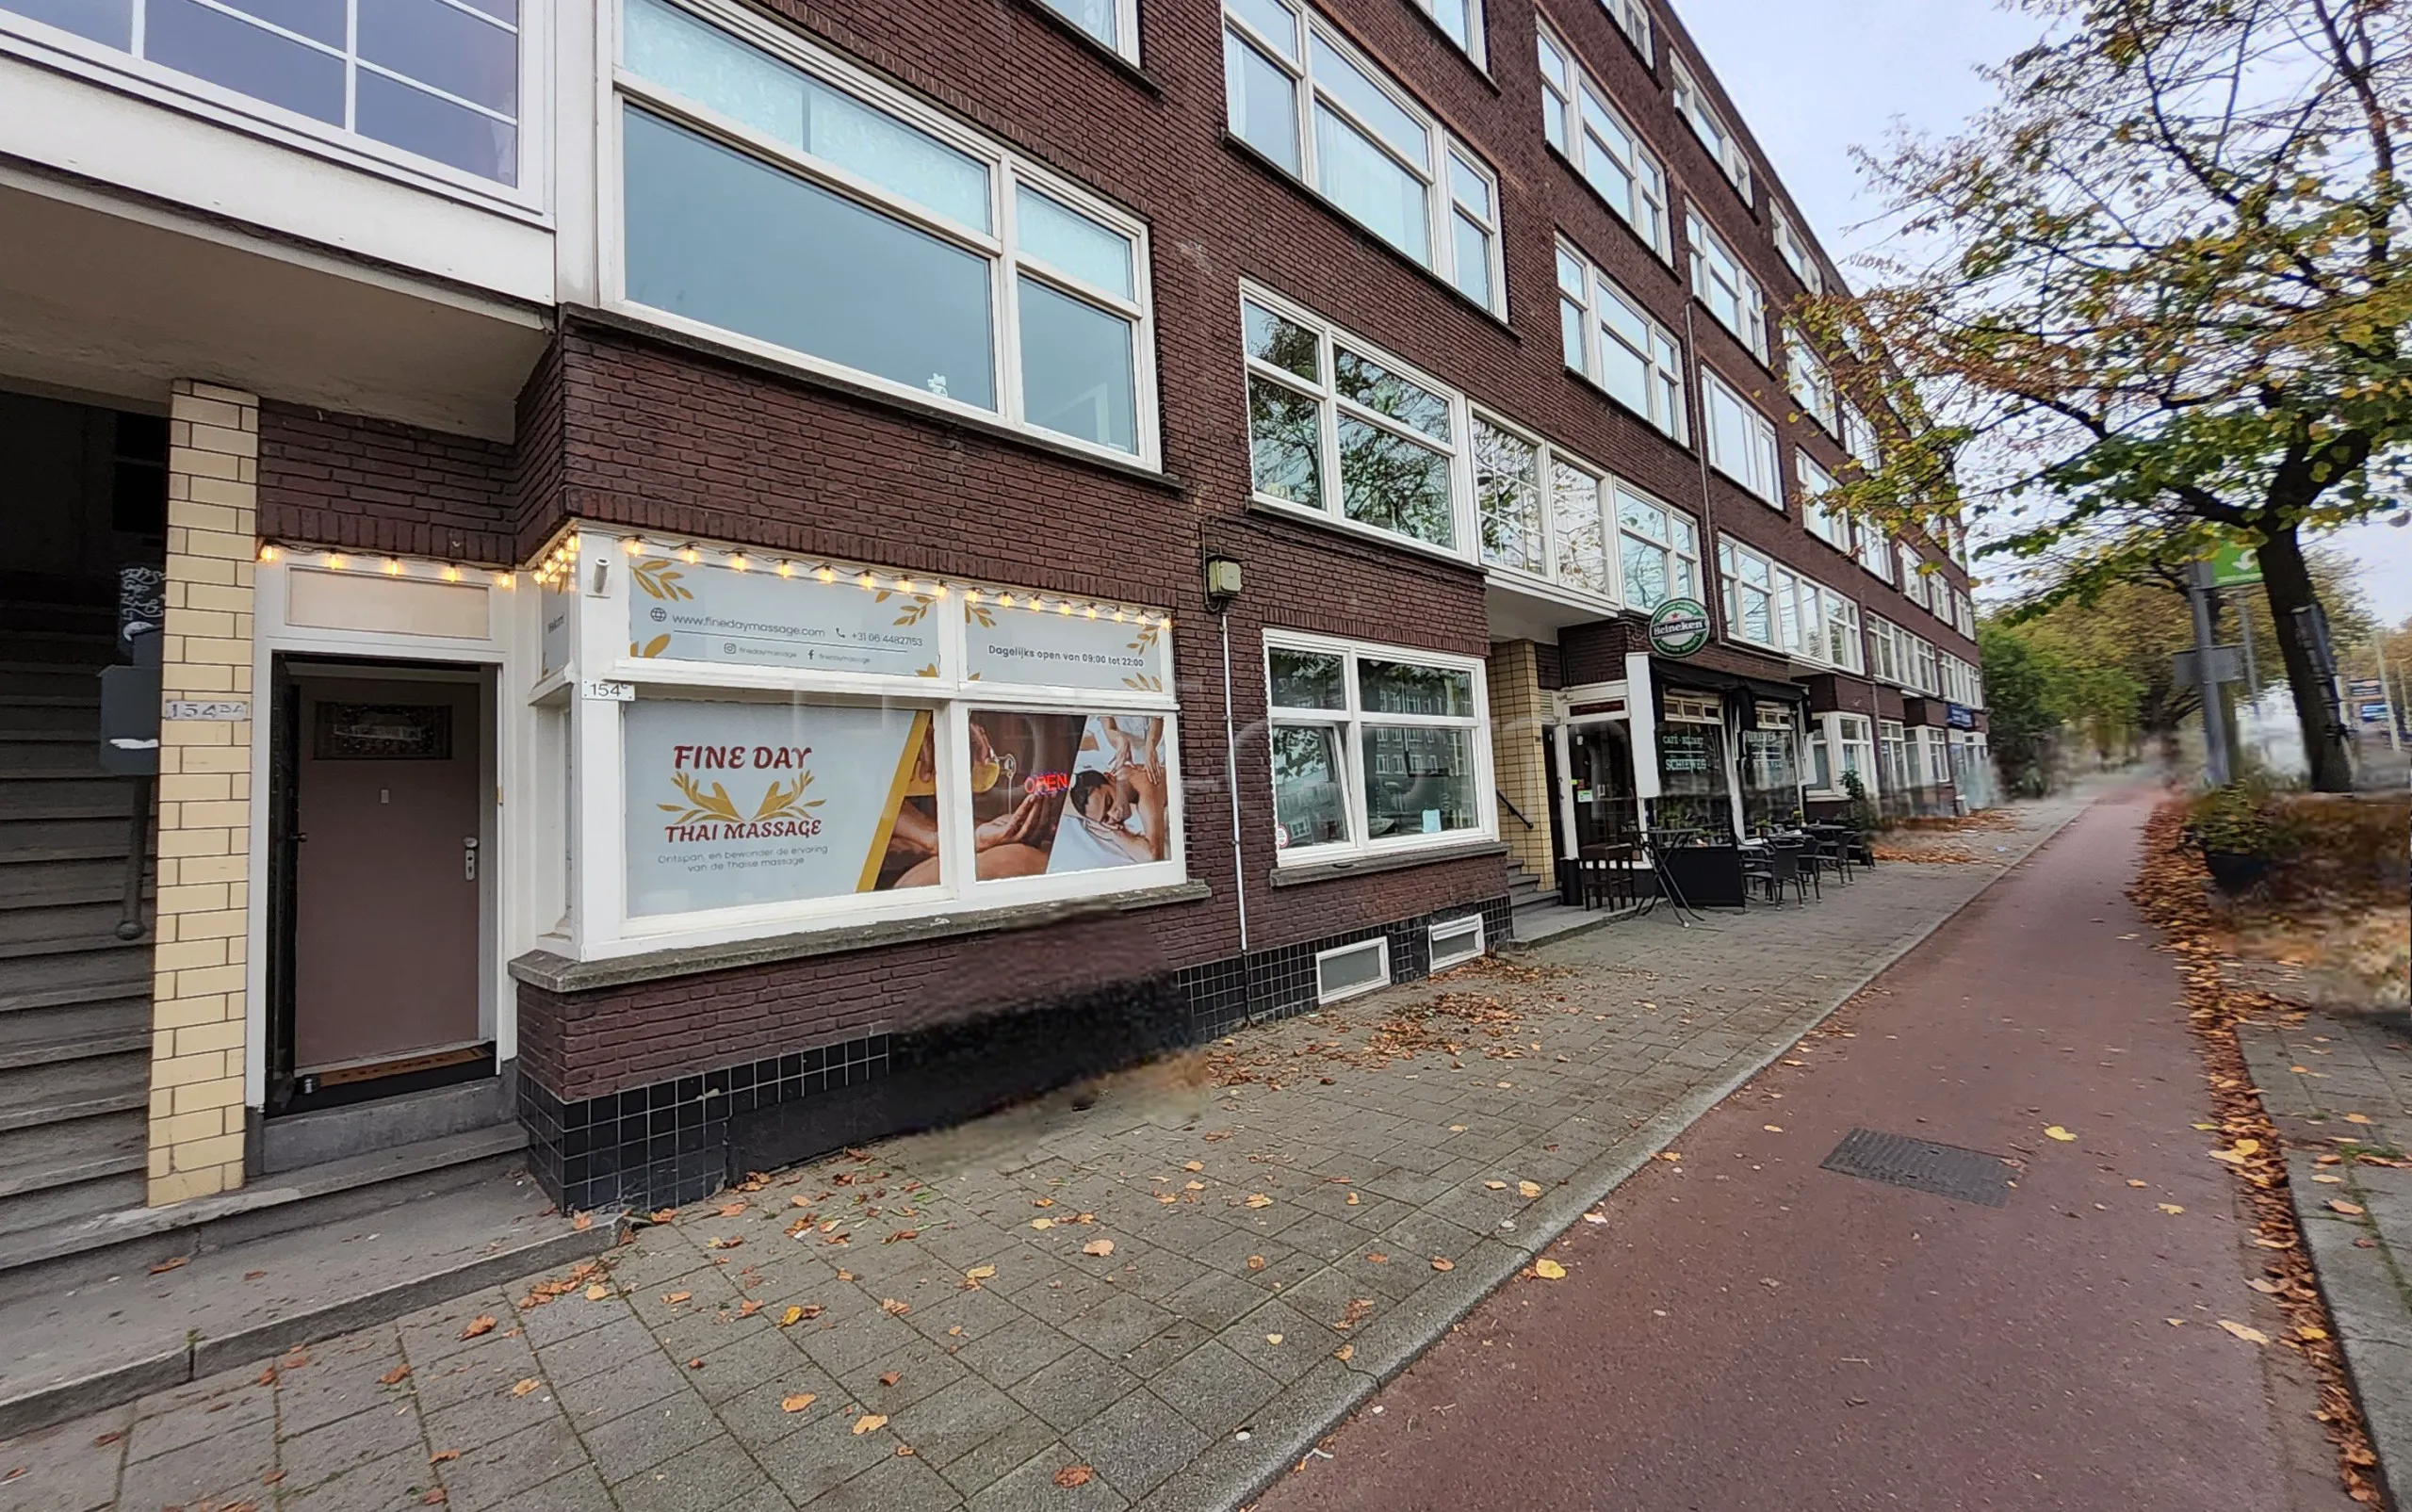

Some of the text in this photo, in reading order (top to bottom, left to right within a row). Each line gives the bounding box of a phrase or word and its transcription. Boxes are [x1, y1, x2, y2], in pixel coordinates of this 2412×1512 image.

[672, 614, 826, 638] www.finedaymassage.com
[852, 632, 867, 642] +31
[868, 633, 881, 642] 06
[1653, 621, 1703, 636] Heineken
[988, 644, 1144, 667] Dagelijks open van 09:00 tot 22:00
[674, 745, 812, 770] FINE DAY
[1024, 772, 1067, 793] OPEN
[664, 819, 823, 843] THAI MASSAGE
[688, 864, 708, 872] van
